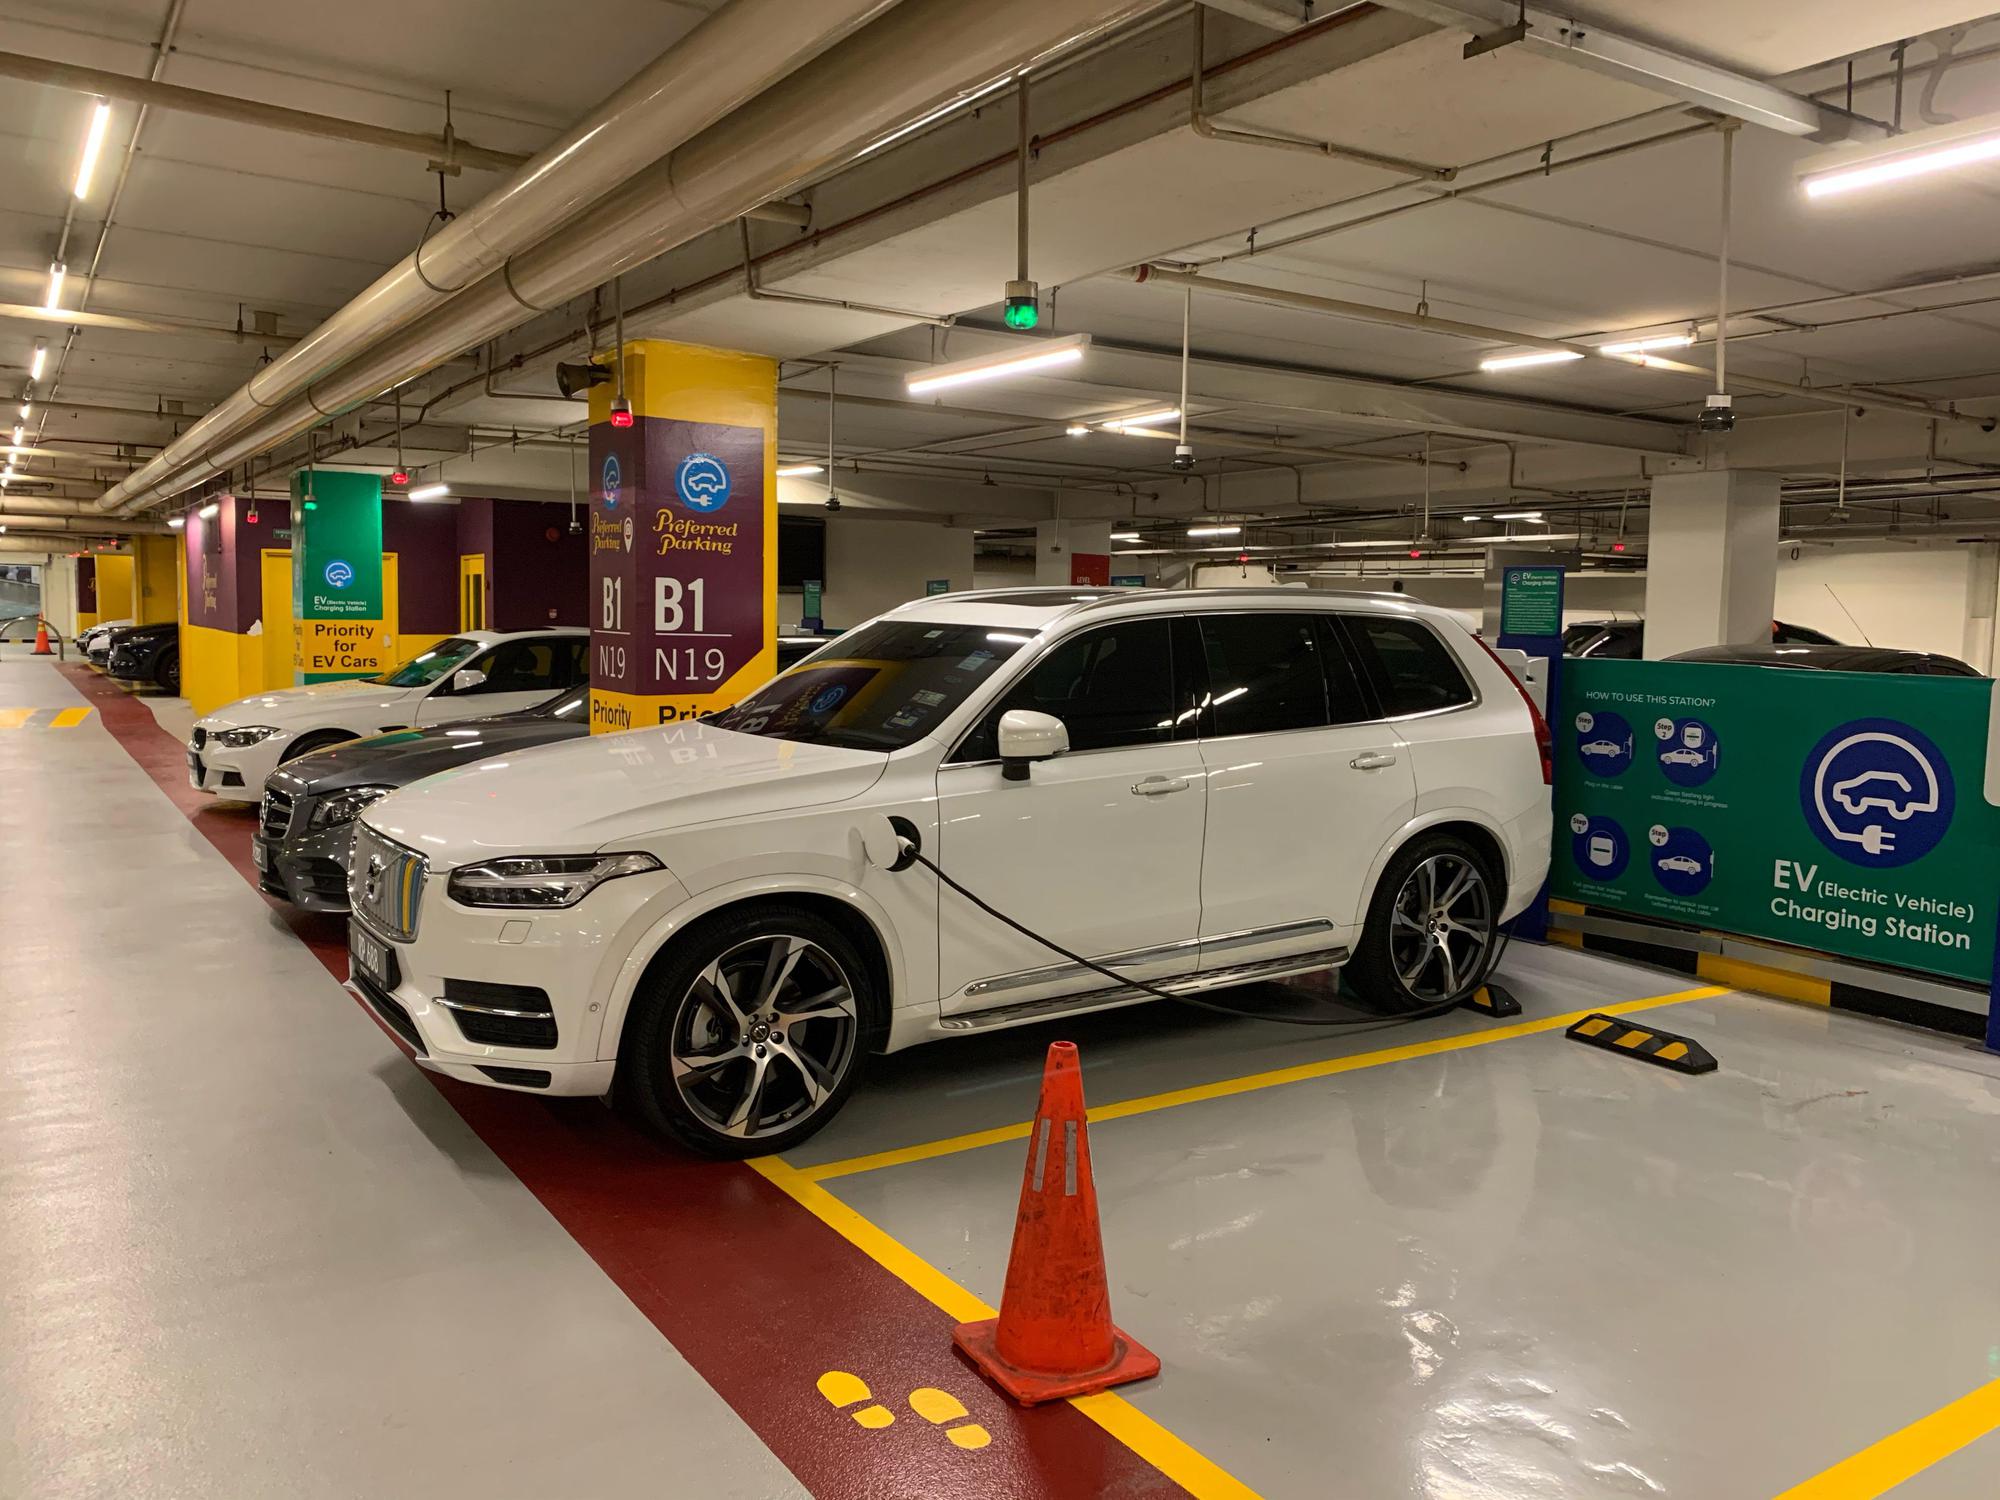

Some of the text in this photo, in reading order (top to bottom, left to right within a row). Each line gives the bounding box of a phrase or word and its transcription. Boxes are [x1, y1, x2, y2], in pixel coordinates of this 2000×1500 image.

[652, 508, 738, 538] Preferred
[657, 533, 732, 555] Parking
[314, 596, 327, 604] EV
[603, 576, 622, 630] B1
[655, 577, 704, 632] B1
[315, 624, 374, 639] Priority
[334, 640, 357, 652] for
[313, 656, 335, 668] EV
[341, 655, 377, 668] Cars
[600, 645, 625, 679] N19
[656, 648, 724, 681] N19
[1586, 691, 1716, 707] HOW TO USE THIS STATION?
[594, 699, 632, 729] Priority
[1578, 716, 1592, 725] Step
[1657, 722, 1672, 731] Step
[1573, 818, 1587, 826] Step
[1652, 828, 1666, 838] Step
[1774, 859, 1974, 923] EV (Electric Vehicle)
[1770, 897, 1971, 950] Charging Station
